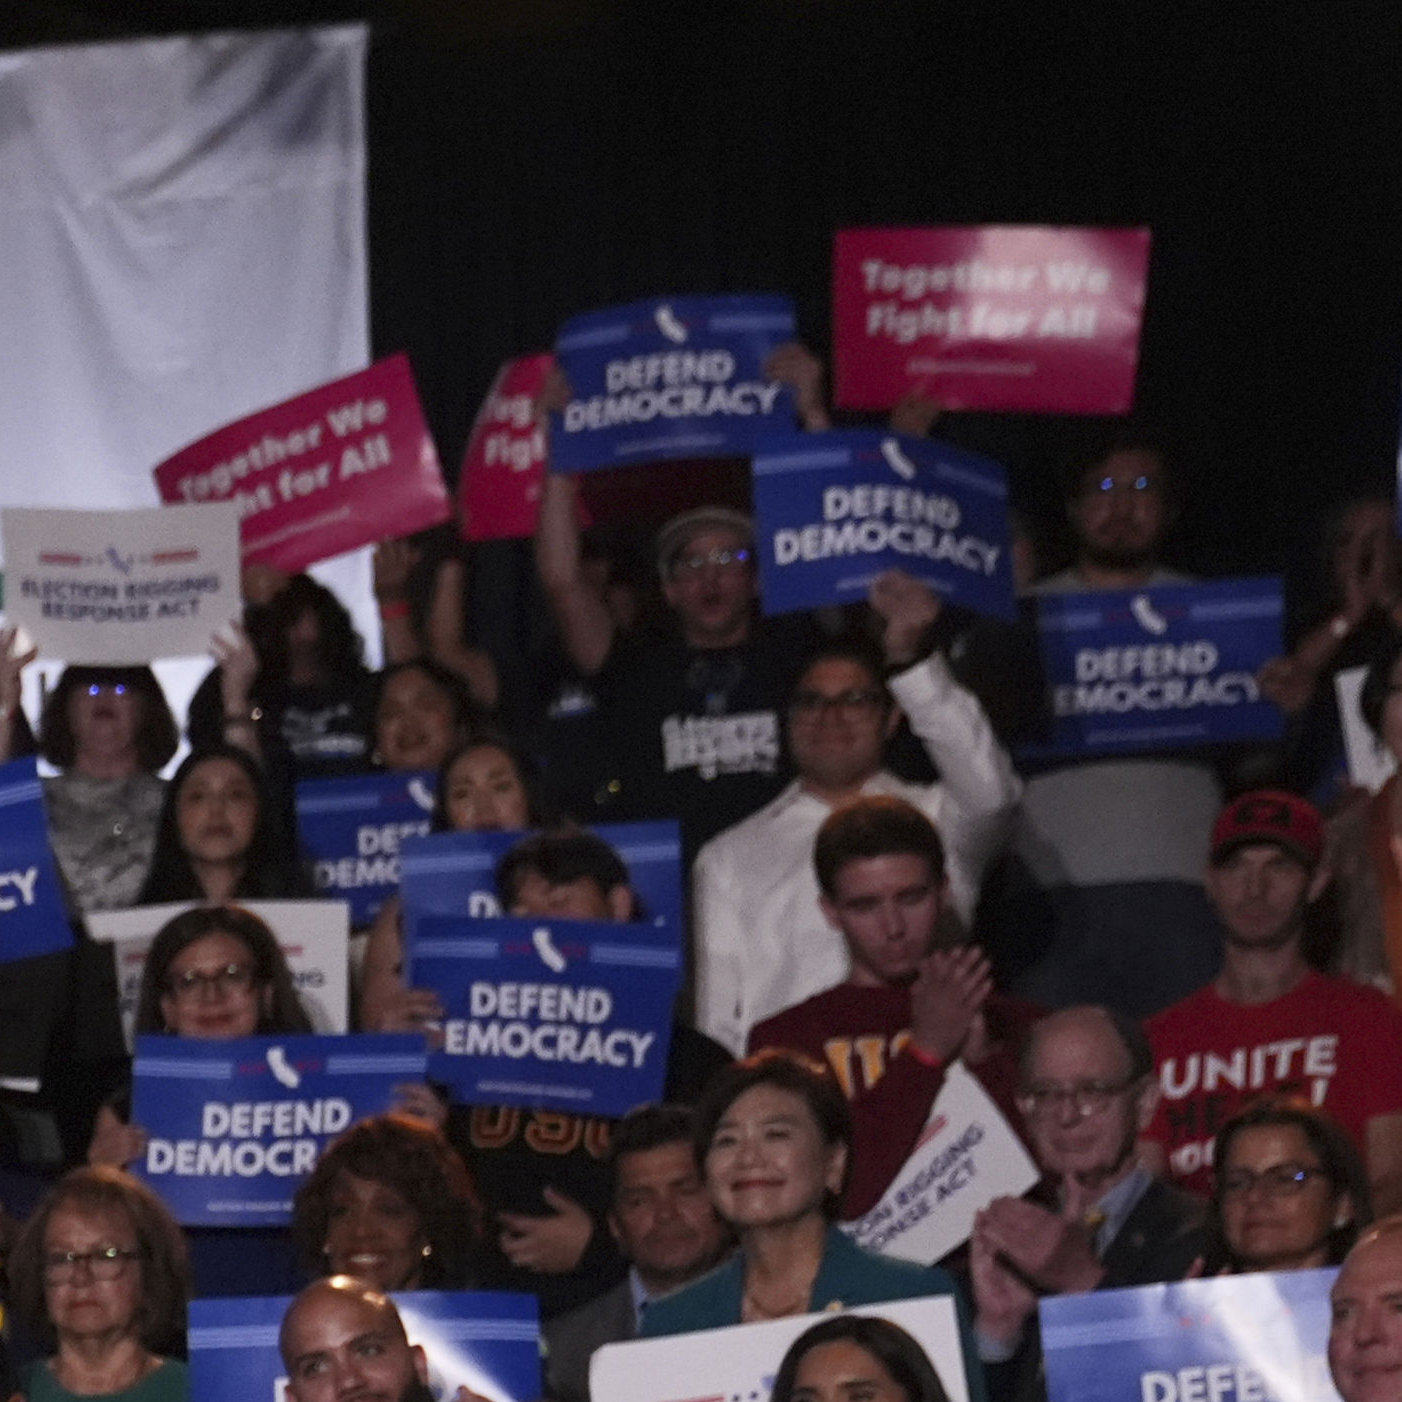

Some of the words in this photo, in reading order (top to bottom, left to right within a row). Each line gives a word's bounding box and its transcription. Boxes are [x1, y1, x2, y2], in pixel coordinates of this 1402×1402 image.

[862, 259, 1037, 300] Together
[866, 301, 963, 343] Fight
[606, 350, 736, 391] DEFEND
[326, 397, 389, 439] We
[564, 382, 781, 433] DEMOCRACY
[278, 461, 331, 502] for
[339, 432, 392, 481] All
[823, 484, 962, 531] DEFEND
[774, 520, 1001, 577] DEMOCRACY
[153, 599, 202, 621] ACT
[1075, 640, 1219, 681] DEFEND
[470, 981, 613, 1025] DEFEND
[433, 1019, 656, 1068] EMOCRACY
[1160, 1034, 1340, 1100] UNITE
[202, 1098, 352, 1139] DEFEND
[147, 1138, 317, 1177] DEMOCR
[895, 1122, 986, 1208] RIGGING
[936, 1156, 977, 1201] ACT
